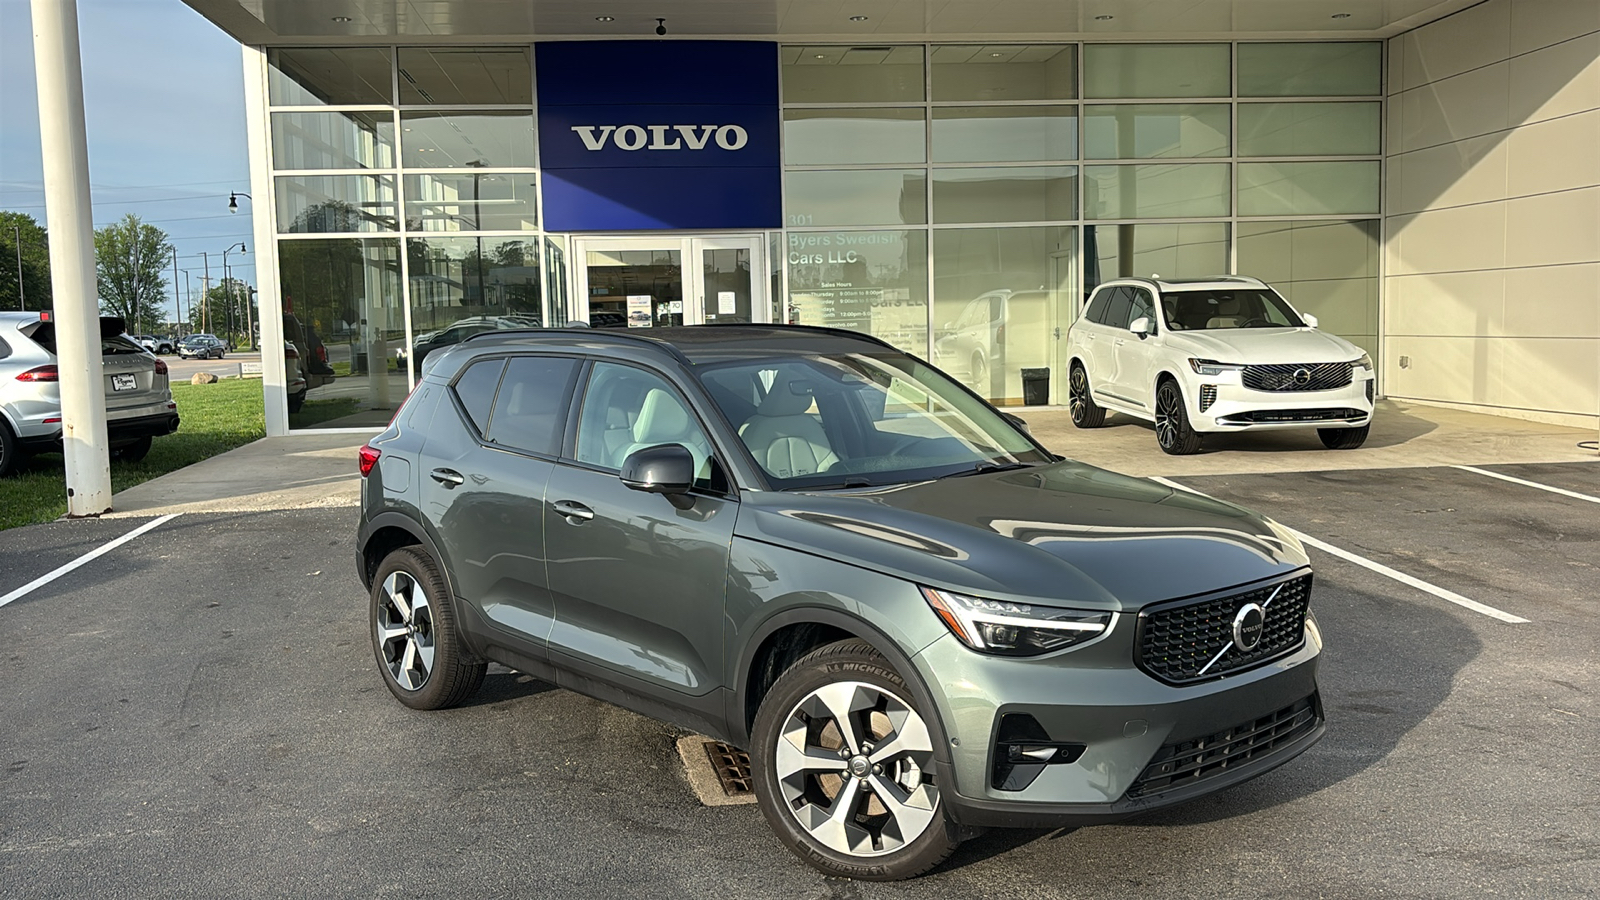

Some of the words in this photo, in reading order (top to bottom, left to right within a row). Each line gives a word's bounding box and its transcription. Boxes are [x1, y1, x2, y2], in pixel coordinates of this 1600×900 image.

[571, 124, 748, 150] VOLVO
[789, 214, 813, 225] 301
[789, 234, 831, 249] Byers
[836, 232, 897, 245] Swedish
[789, 251, 823, 264] Cars
[828, 250, 857, 263] LLC
[1242, 624, 1262, 633] VOLVO
[842, 663, 903, 685] MICHELIN
